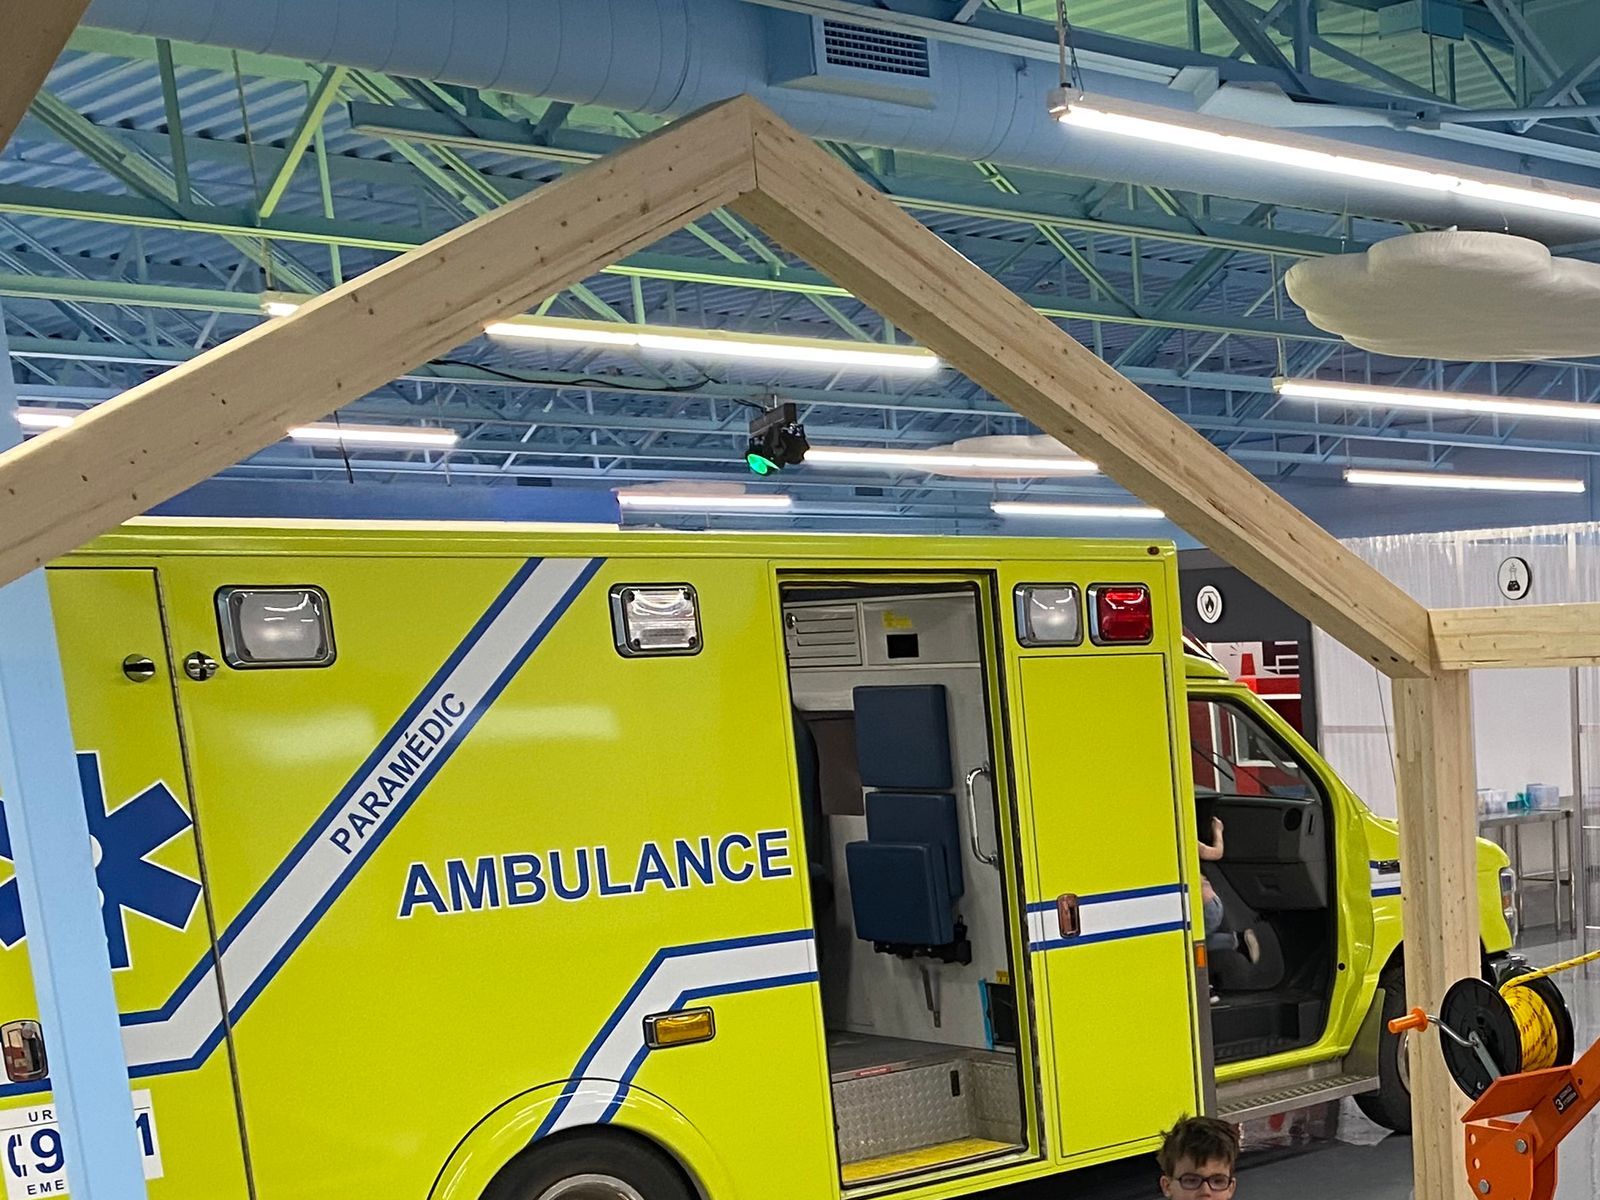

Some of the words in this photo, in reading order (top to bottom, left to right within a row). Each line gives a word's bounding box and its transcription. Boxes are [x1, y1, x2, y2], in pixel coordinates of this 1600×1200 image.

[329, 693, 465, 855] PARAMÉDIC
[397, 829, 794, 919] AMBULANCE
[1555, 1098, 1564, 1111] 3
